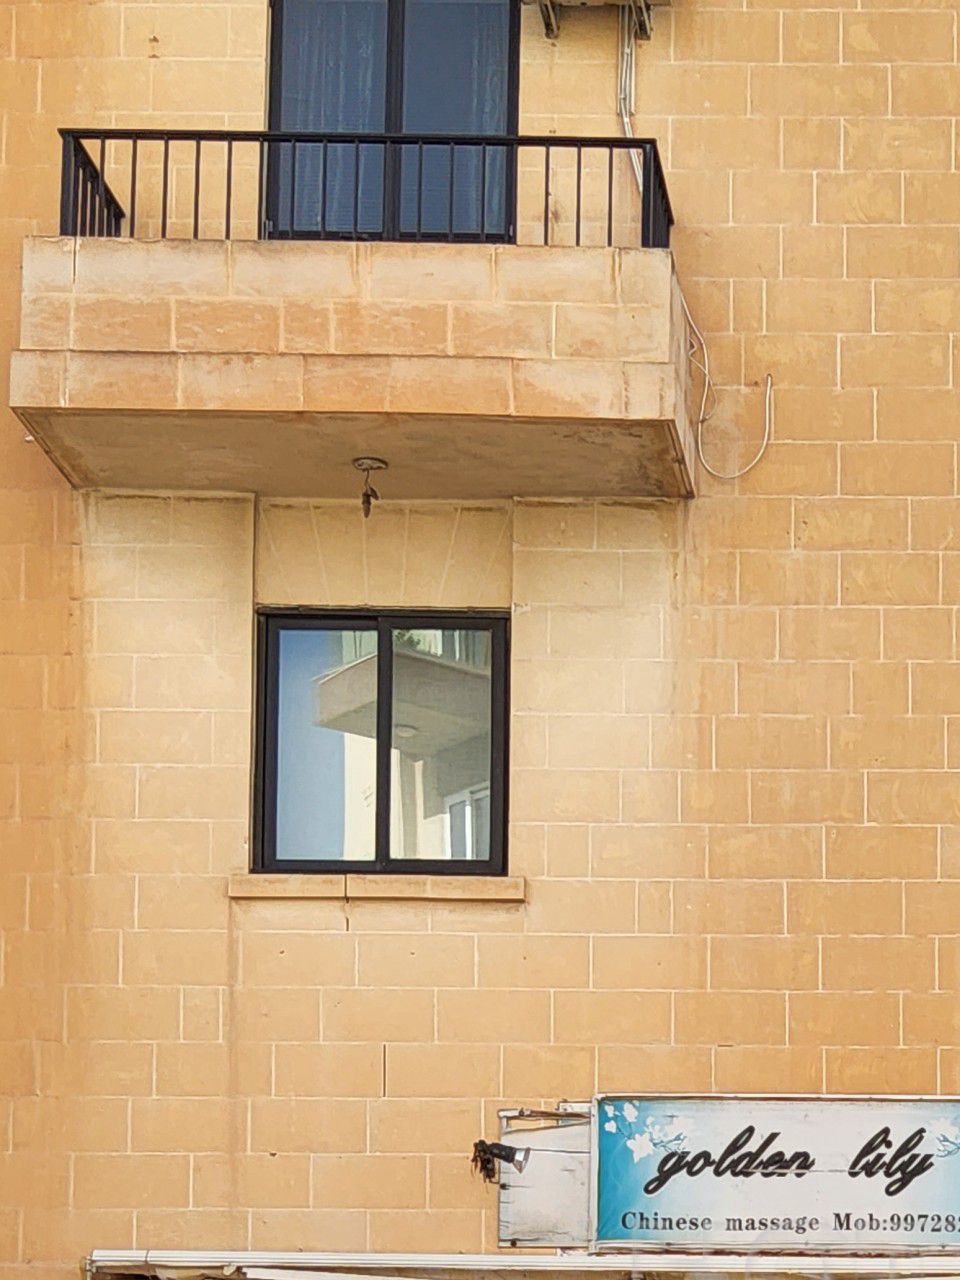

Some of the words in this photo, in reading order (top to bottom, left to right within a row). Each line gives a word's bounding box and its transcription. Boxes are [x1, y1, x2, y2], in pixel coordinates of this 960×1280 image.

[643, 1125, 816, 1195] golden
[848, 1126, 935, 1197] lily
[621, 1211, 713, 1231] Chinese
[725, 1216, 820, 1234] massage
